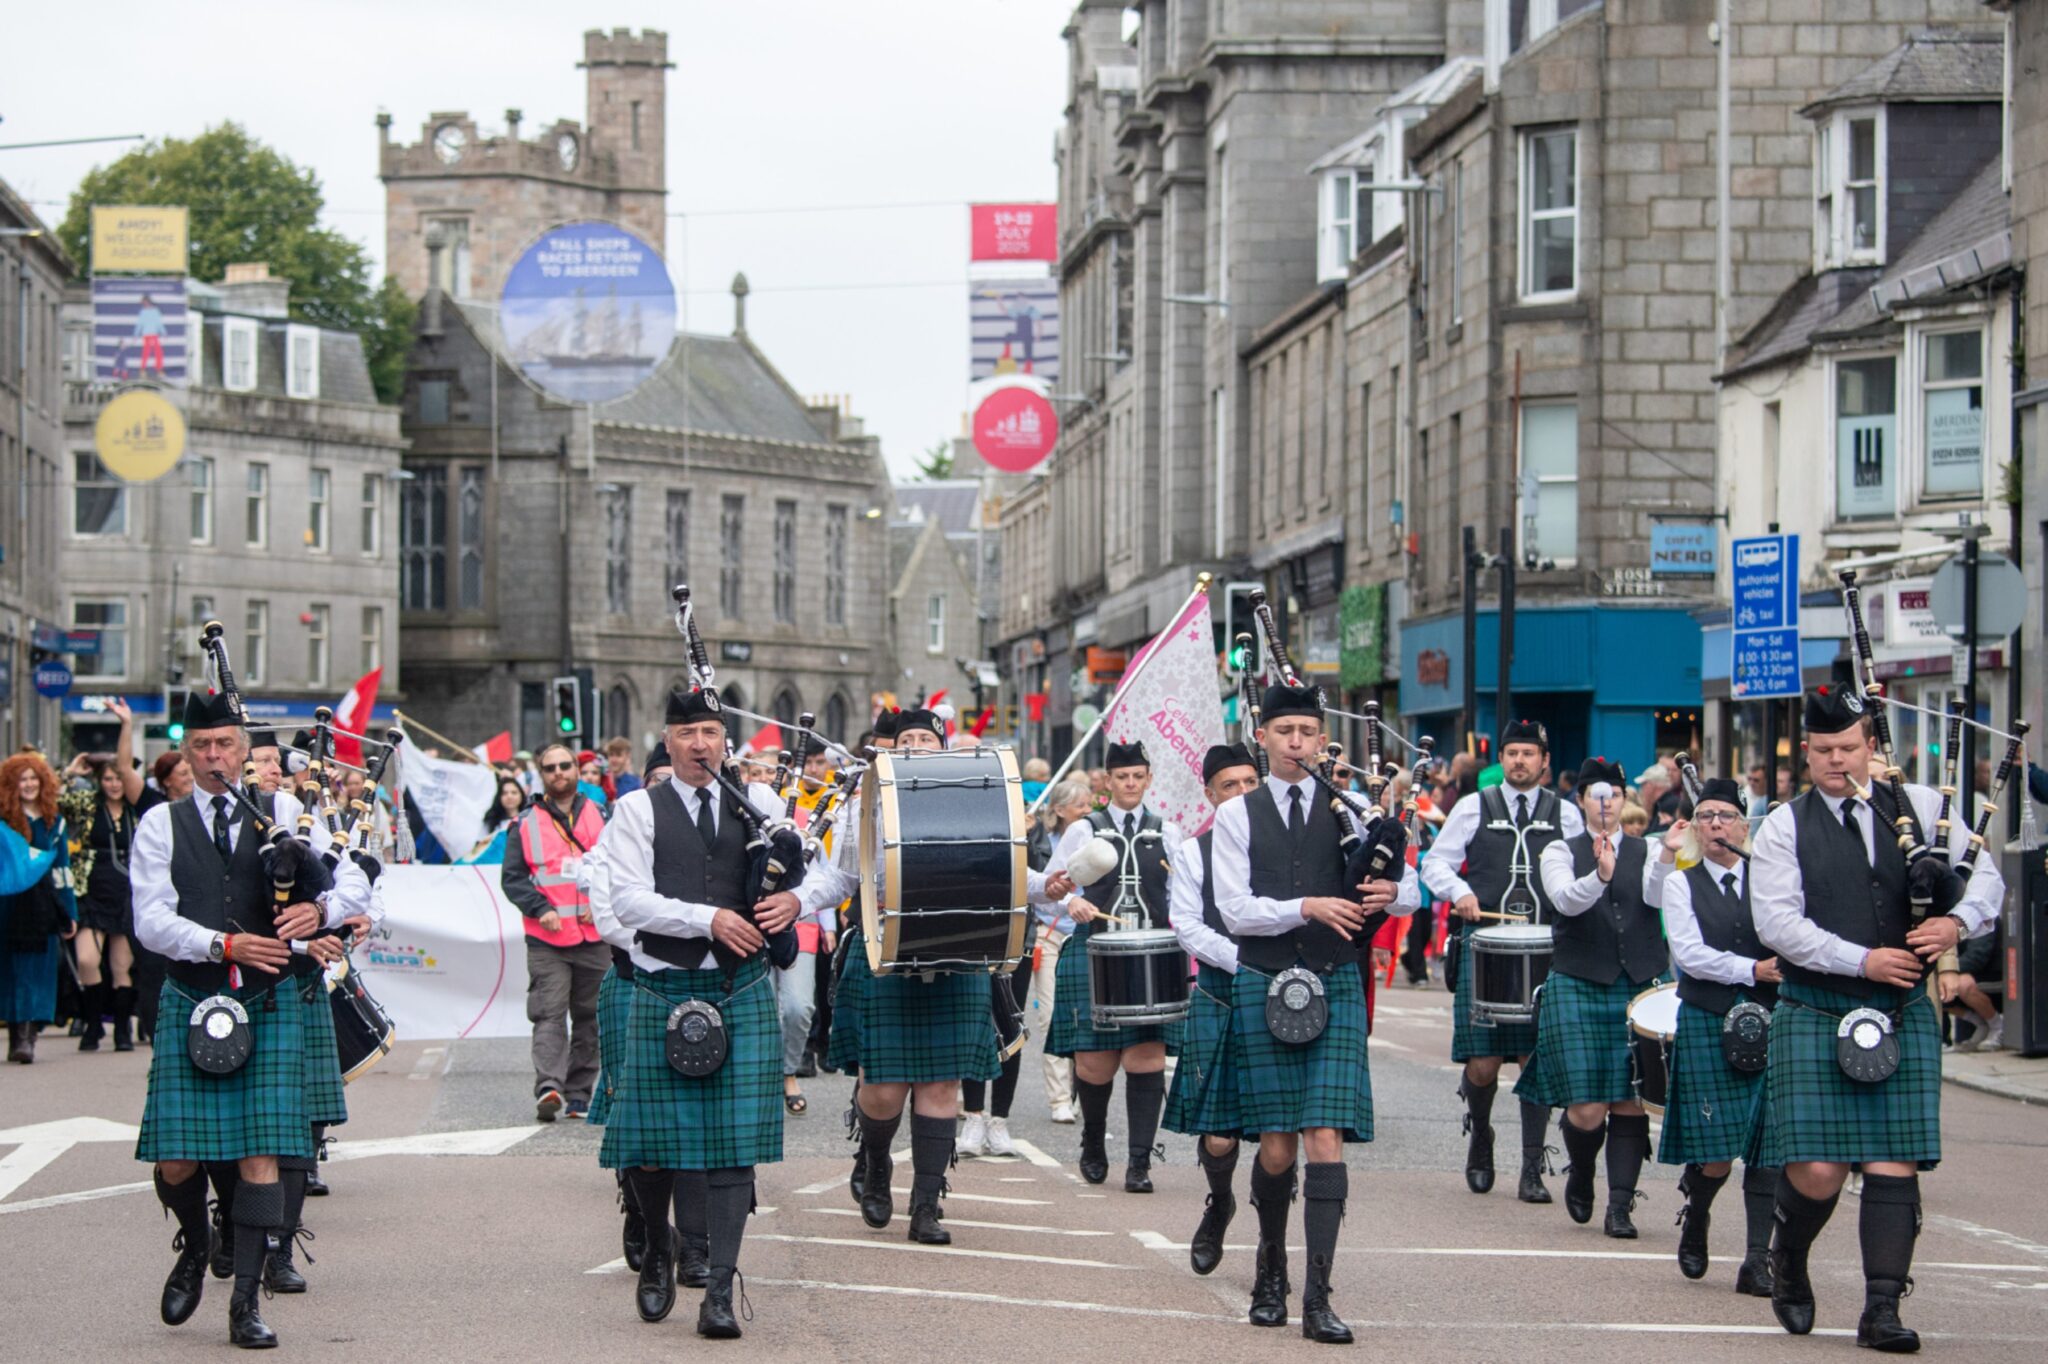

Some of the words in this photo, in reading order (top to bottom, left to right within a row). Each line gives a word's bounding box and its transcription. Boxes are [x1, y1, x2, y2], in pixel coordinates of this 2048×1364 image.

[104, 232, 175, 246] WELCOME
[996, 226, 1031, 240] JULY
[549, 238, 582, 251] TALL
[586, 237, 630, 250] SHIPS
[537, 251, 582, 264] RACES
[585, 250, 643, 263] RETURN
[541, 265, 561, 277] TO
[563, 264, 639, 277] ABERDEEN
[1933, 413, 1981, 428] ABERDEEN
[1654, 550, 1713, 563] NERO
[1738, 573, 1780, 587] authorised
[1602, 581, 1665, 596] STREET
[1743, 588, 1775, 600] vehicles
[1759, 608, 1775, 620] taxi
[1919, 628, 1944, 636] SALE
[1164, 697, 1209, 754] Celebrate
[370, 950, 420, 966] Rara
